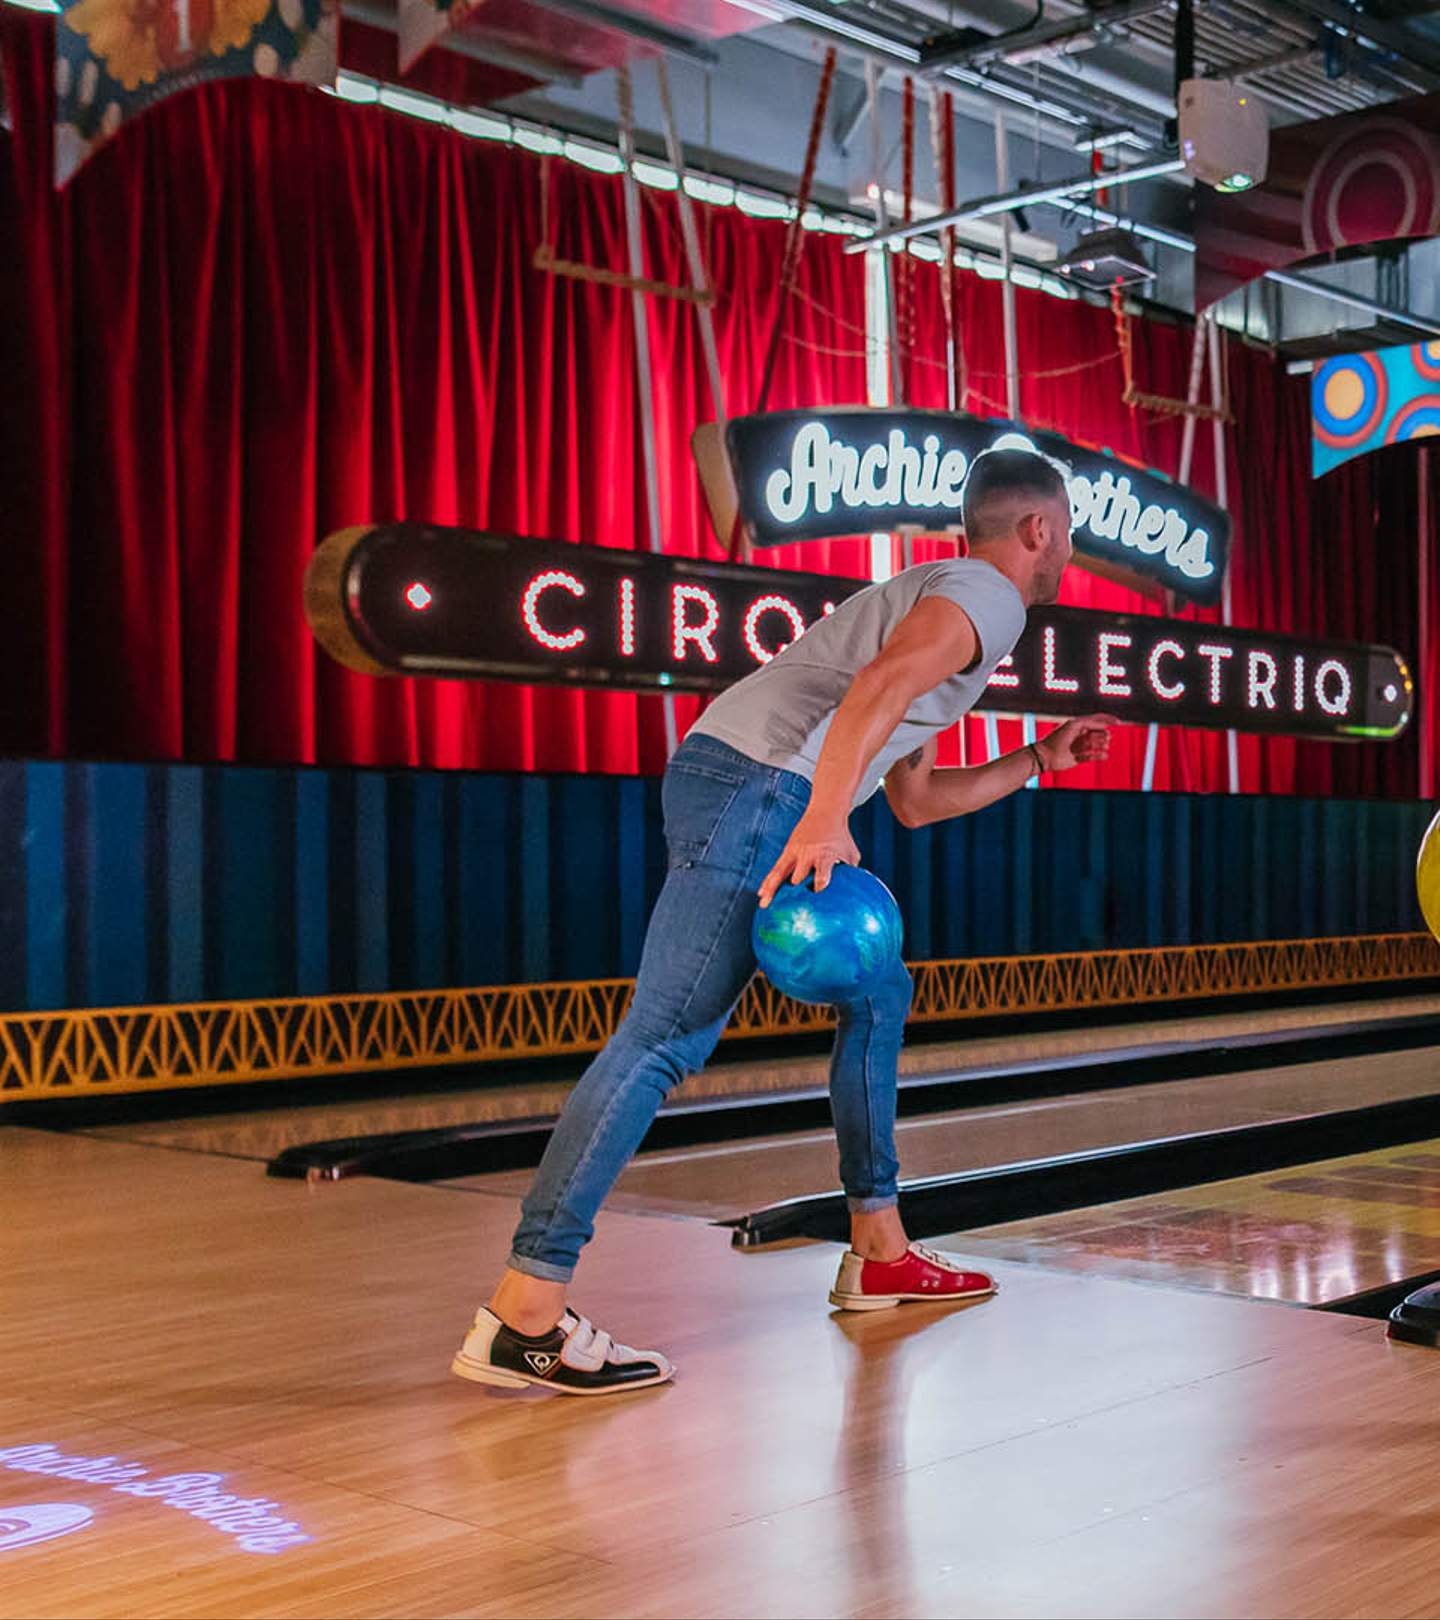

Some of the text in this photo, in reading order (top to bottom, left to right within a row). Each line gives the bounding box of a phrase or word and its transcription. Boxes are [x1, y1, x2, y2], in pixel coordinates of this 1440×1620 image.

[766, 421, 1215, 579] Archie others
[522, 571, 838, 664] CIRQ
